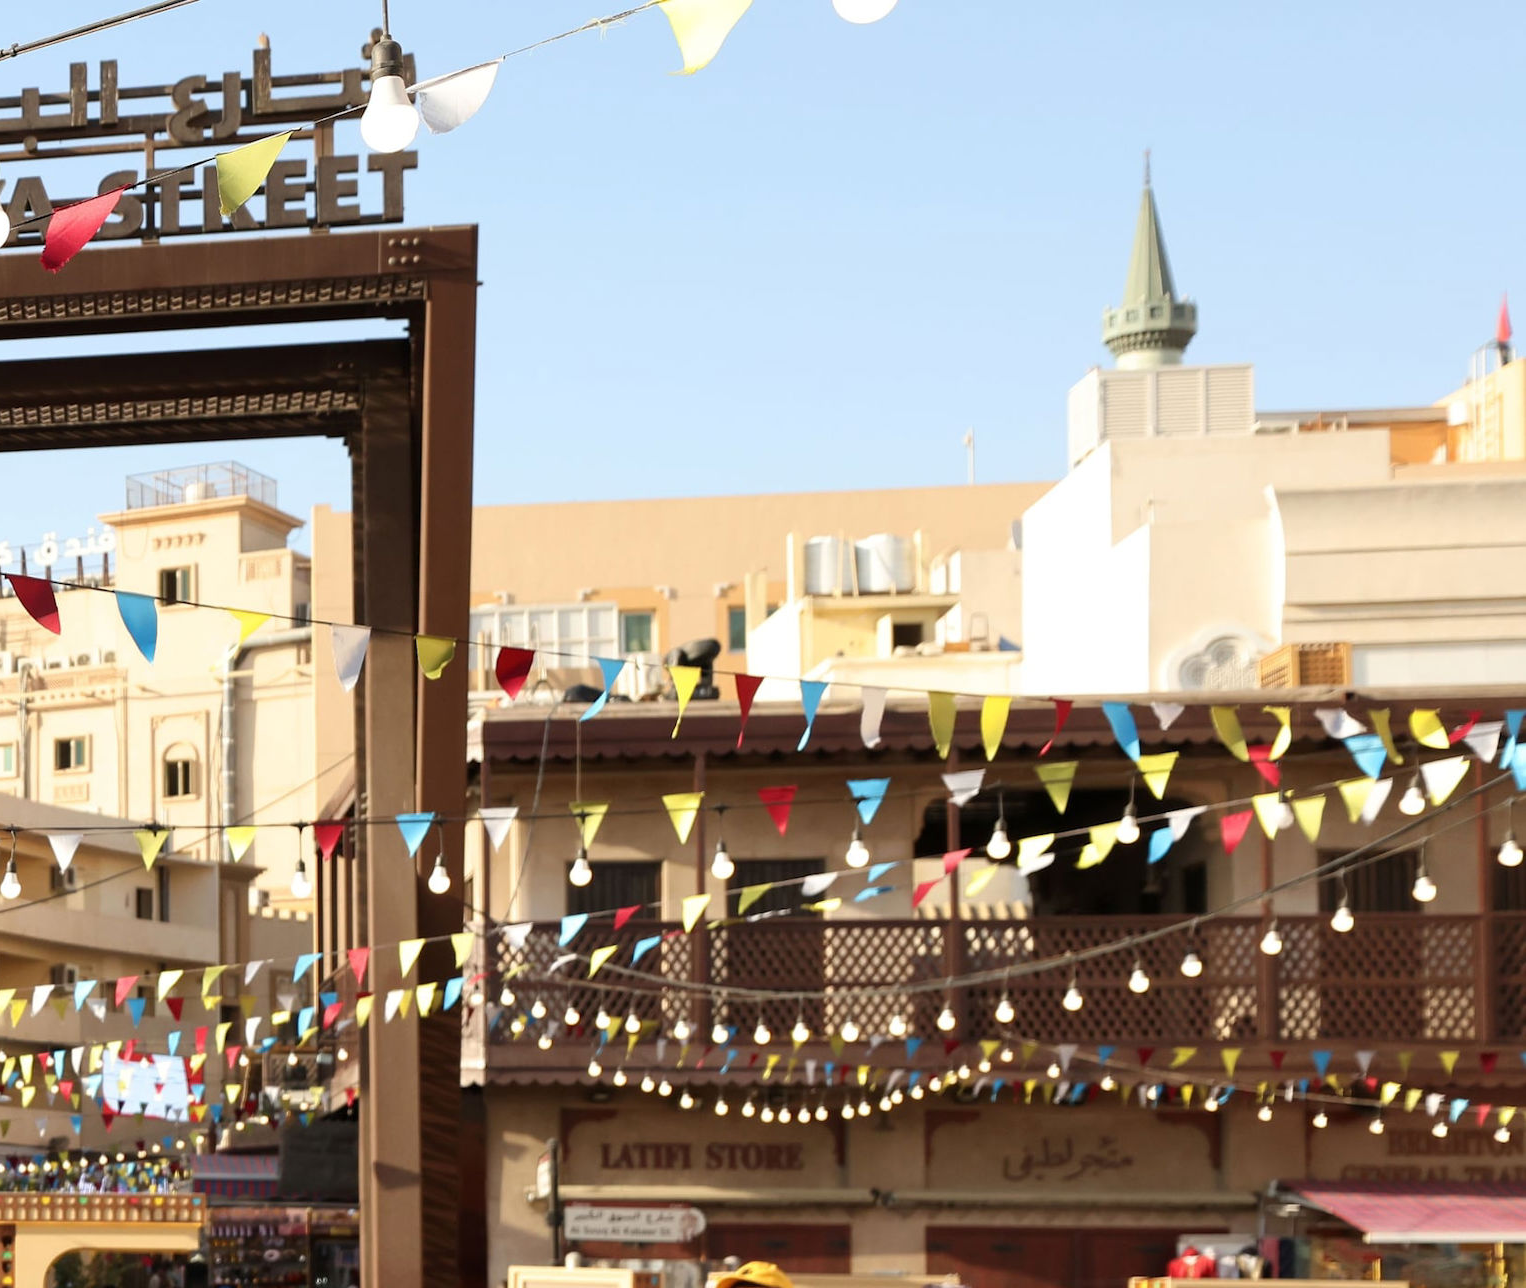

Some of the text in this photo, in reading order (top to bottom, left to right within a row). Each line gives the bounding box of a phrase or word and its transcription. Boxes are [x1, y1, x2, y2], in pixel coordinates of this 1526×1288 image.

[97, 151, 419, 239] STREET
[600, 1140, 805, 1172] LATIFI STORE
